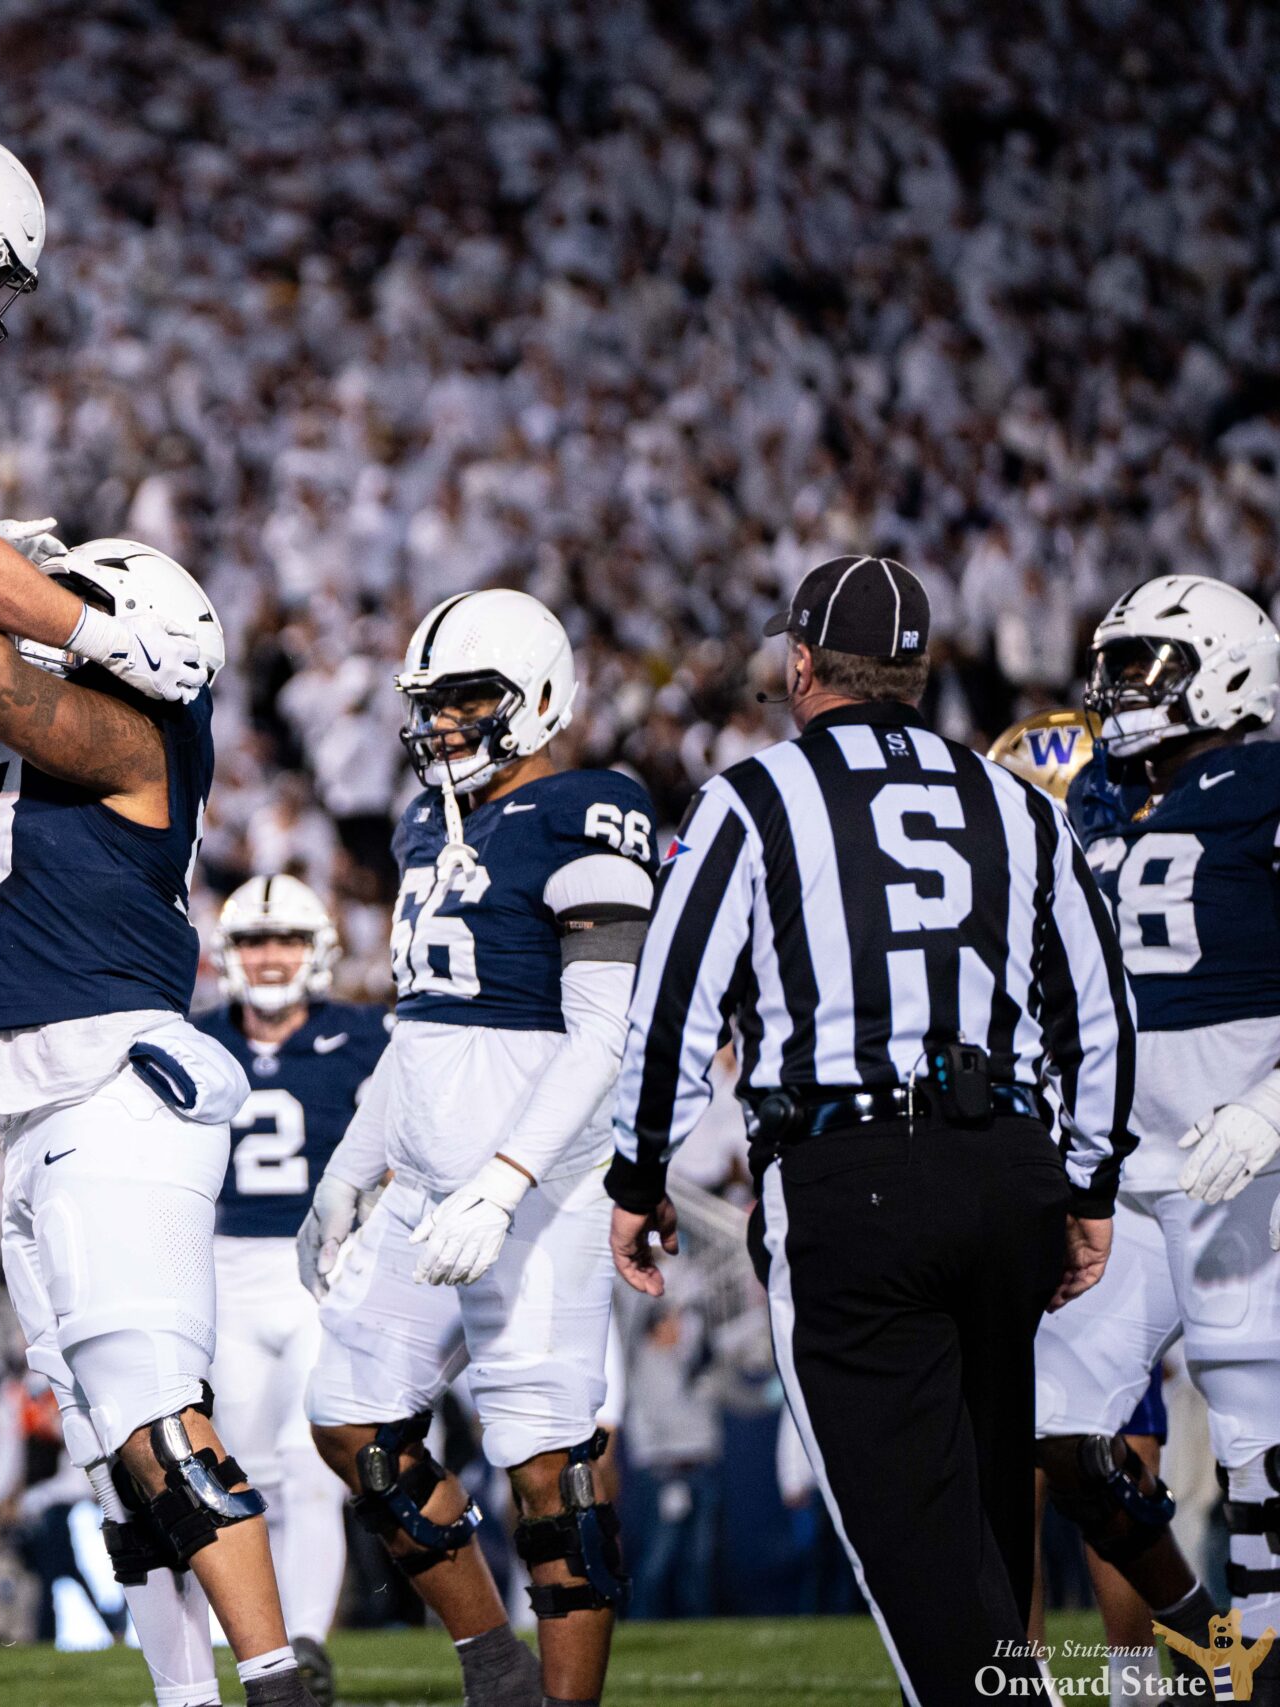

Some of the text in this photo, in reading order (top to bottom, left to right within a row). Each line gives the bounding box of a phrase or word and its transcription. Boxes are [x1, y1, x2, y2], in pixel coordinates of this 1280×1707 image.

[799, 609, 811, 627] S
[901, 630, 920, 649] RR
[1023, 726, 1086, 766] W
[584, 802, 652, 862] 66
[870, 783, 973, 933] S
[389, 865, 492, 1000] 66
[230, 1088, 309, 1195] 2
